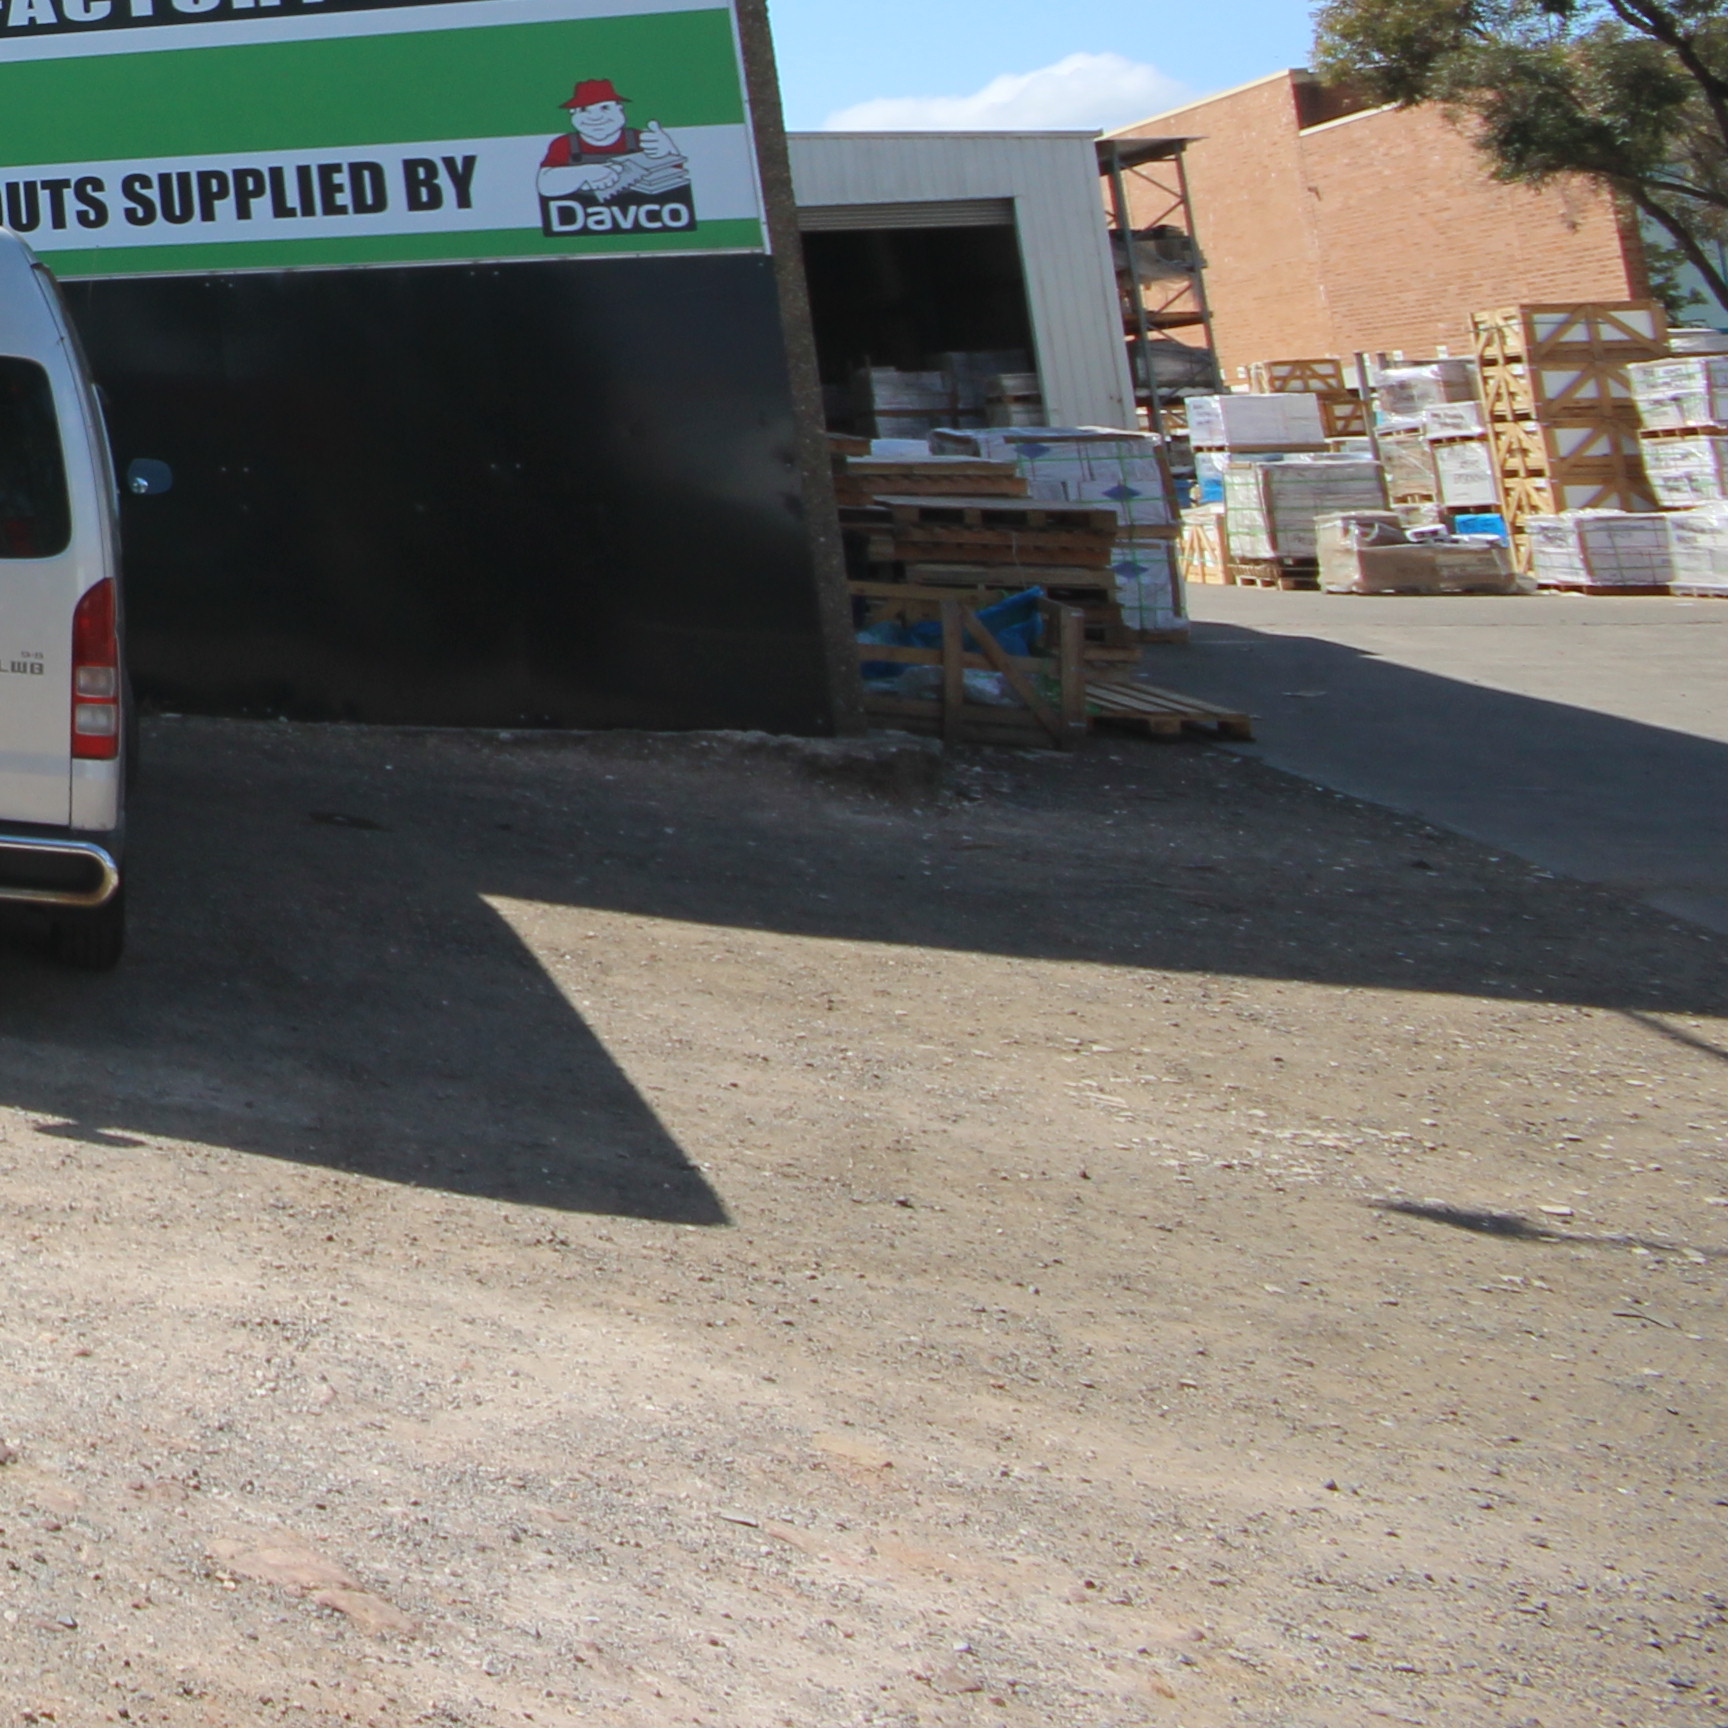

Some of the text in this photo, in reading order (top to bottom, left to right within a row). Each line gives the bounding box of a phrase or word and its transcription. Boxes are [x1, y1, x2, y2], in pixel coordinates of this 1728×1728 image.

[123, 159, 388, 227] SUPPLIED
[402, 154, 477, 212] BY
[549, 198, 690, 233] Davco
